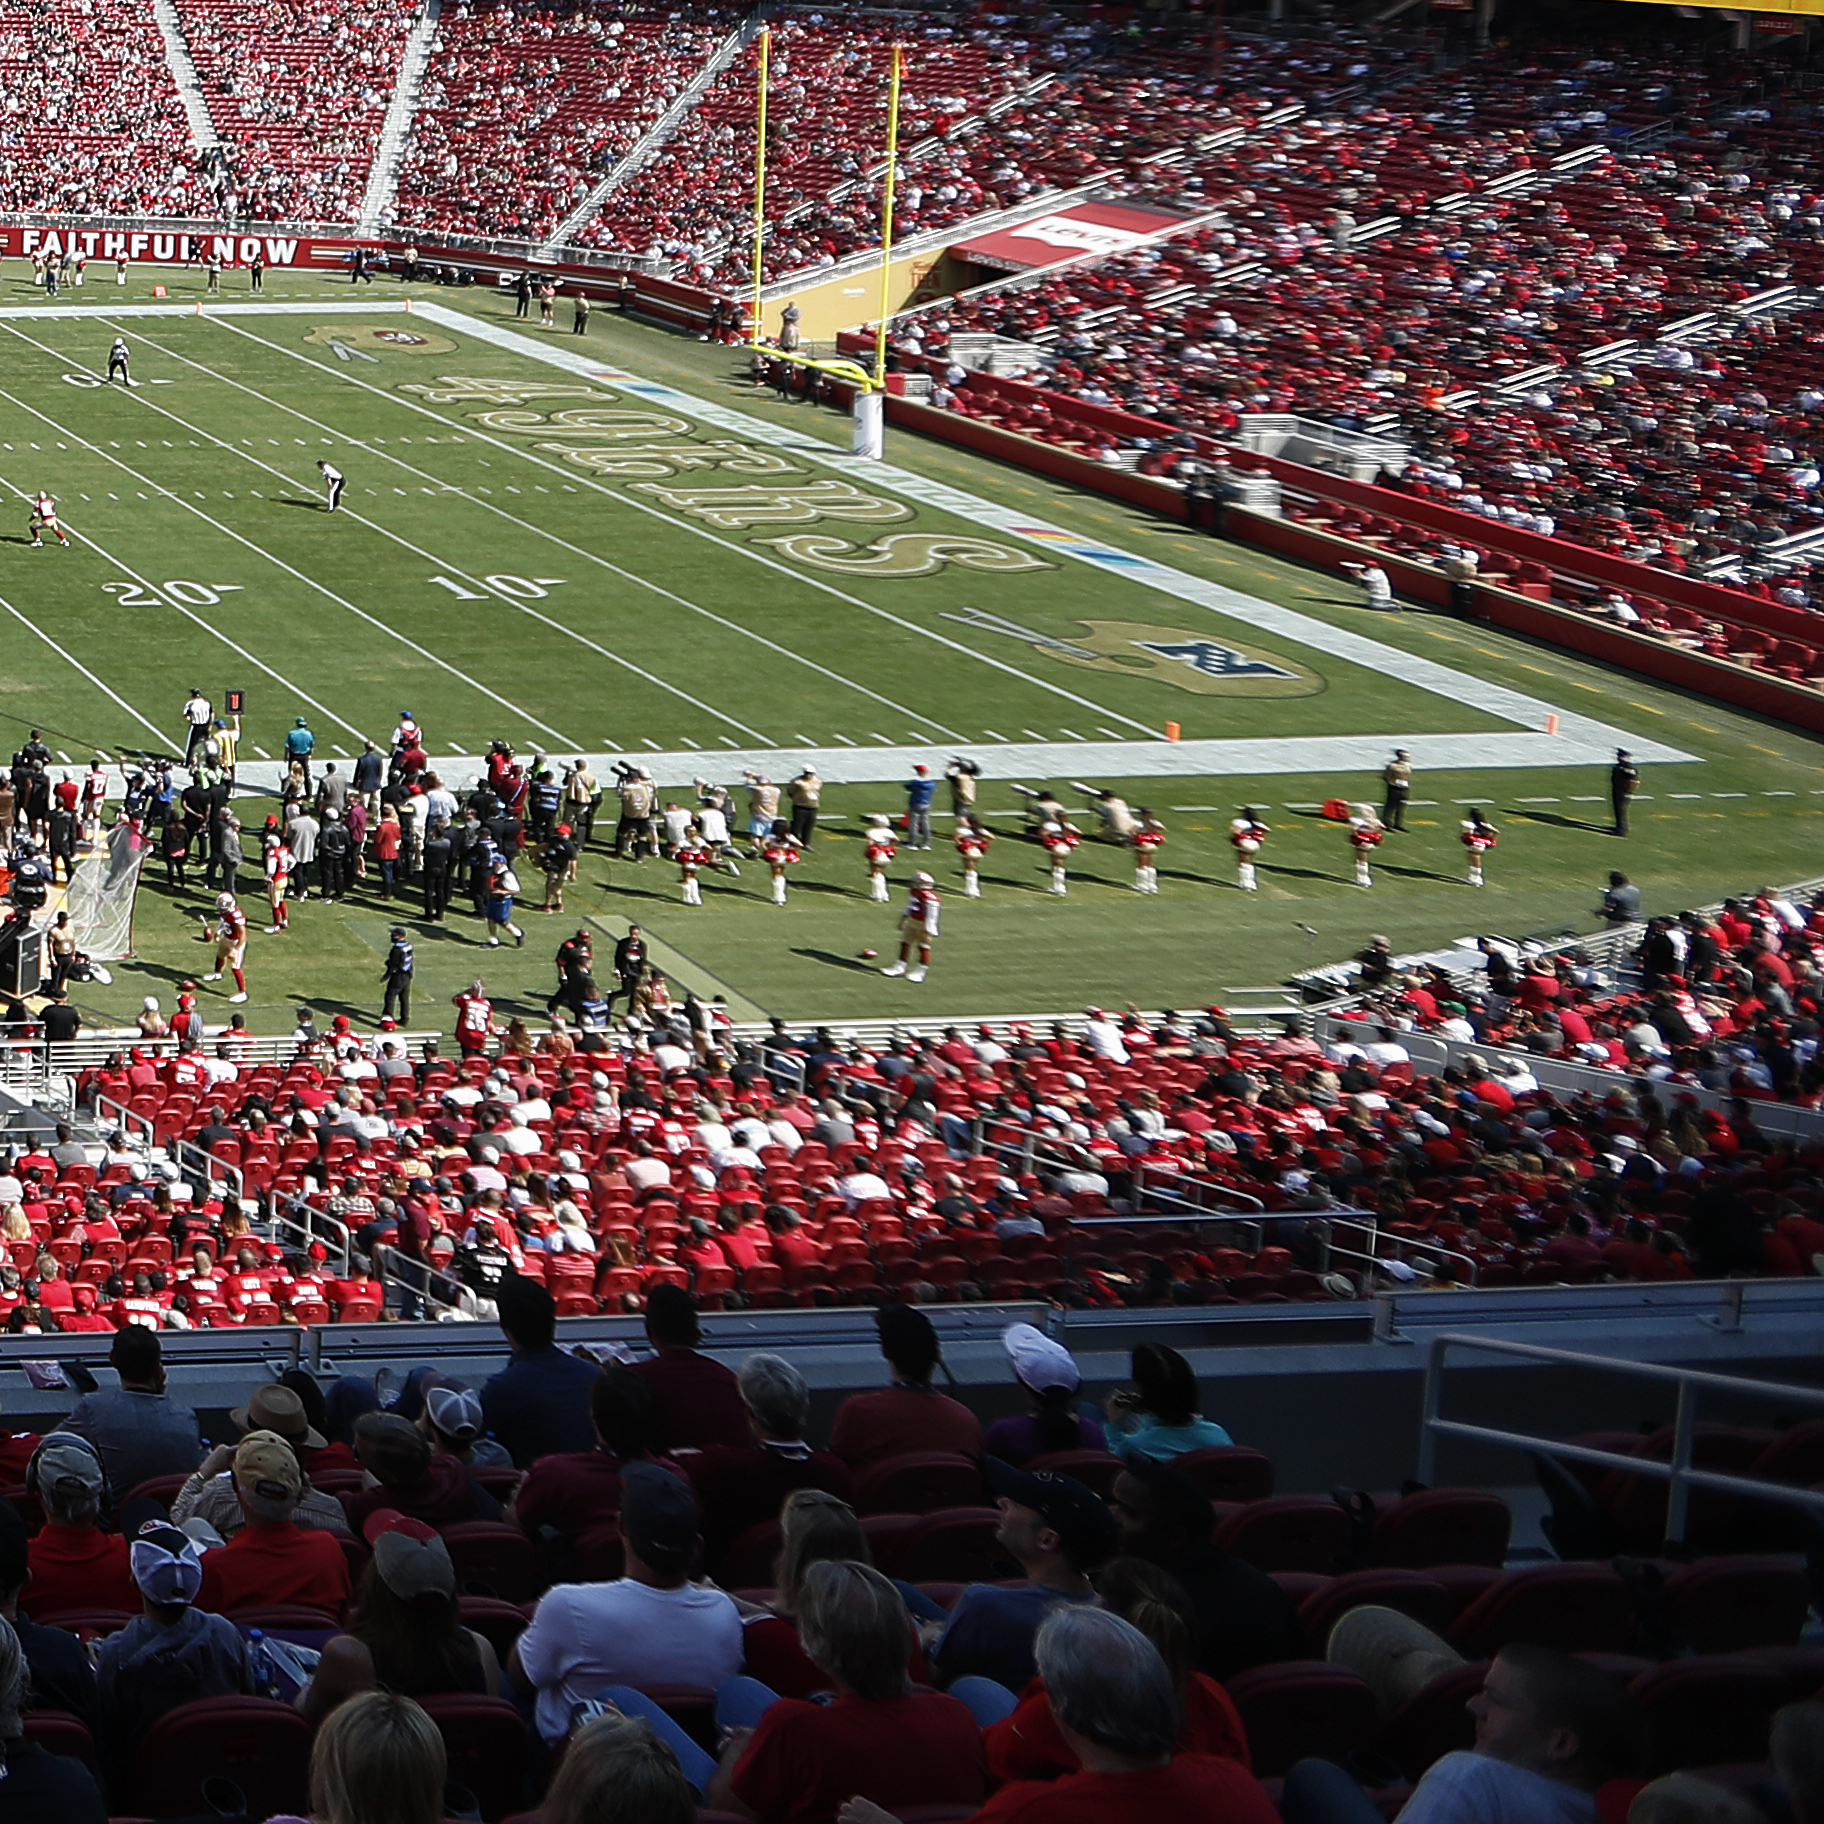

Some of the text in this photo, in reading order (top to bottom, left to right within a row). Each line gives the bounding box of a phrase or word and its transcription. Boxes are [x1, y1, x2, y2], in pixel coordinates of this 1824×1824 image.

[213, 238, 297, 264] NOW
[397, 374, 1061, 578] 49ERS
[102, 582, 222, 606] 20
[428, 576, 549, 600] 10
